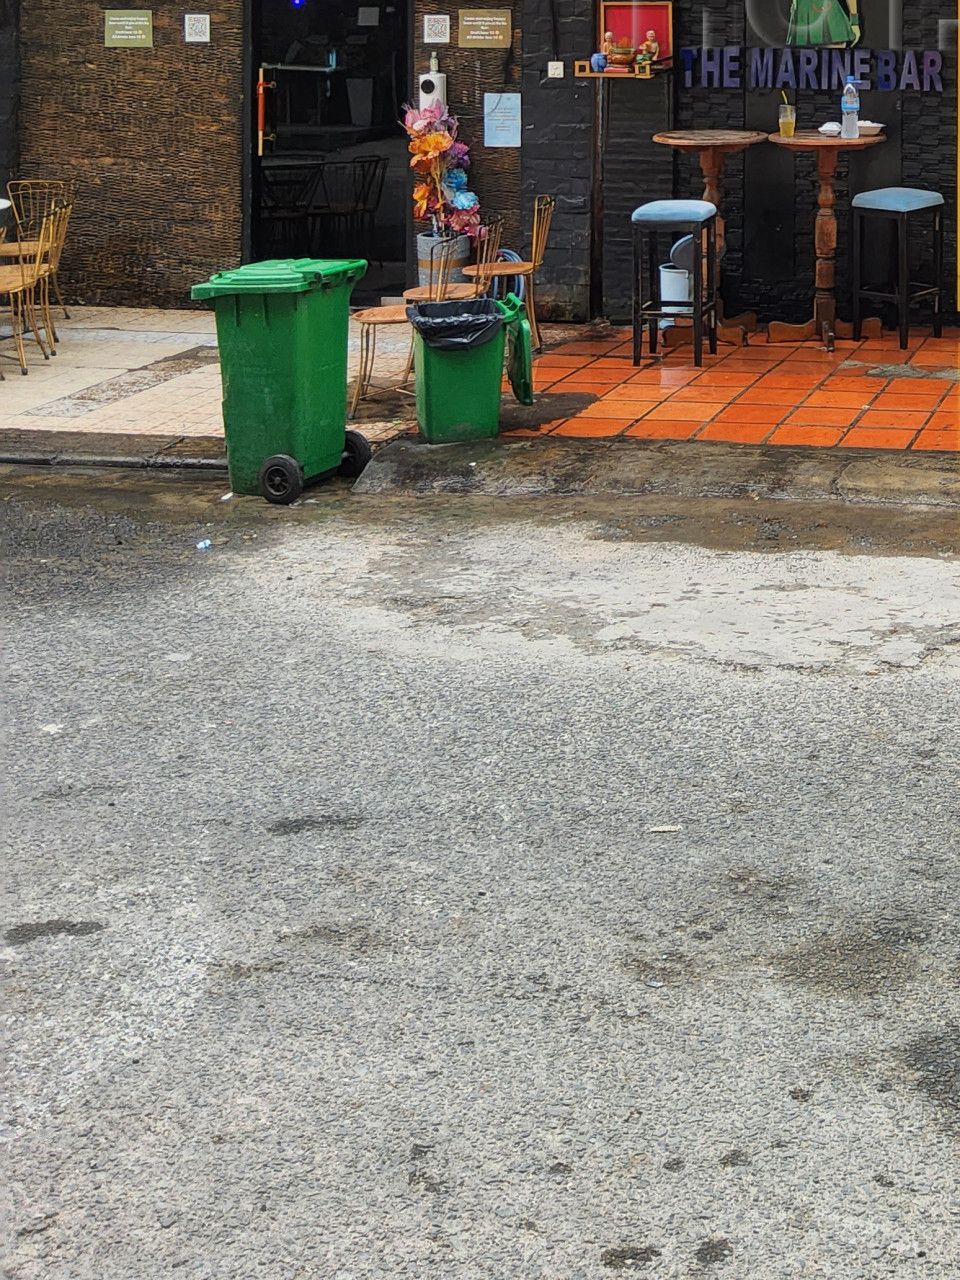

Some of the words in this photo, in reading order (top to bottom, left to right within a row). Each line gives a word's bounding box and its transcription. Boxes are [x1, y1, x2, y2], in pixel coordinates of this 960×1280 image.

[679, 47, 741, 88] THE
[750, 47, 871, 90] MARINE
[876, 50, 943, 92] BAR
